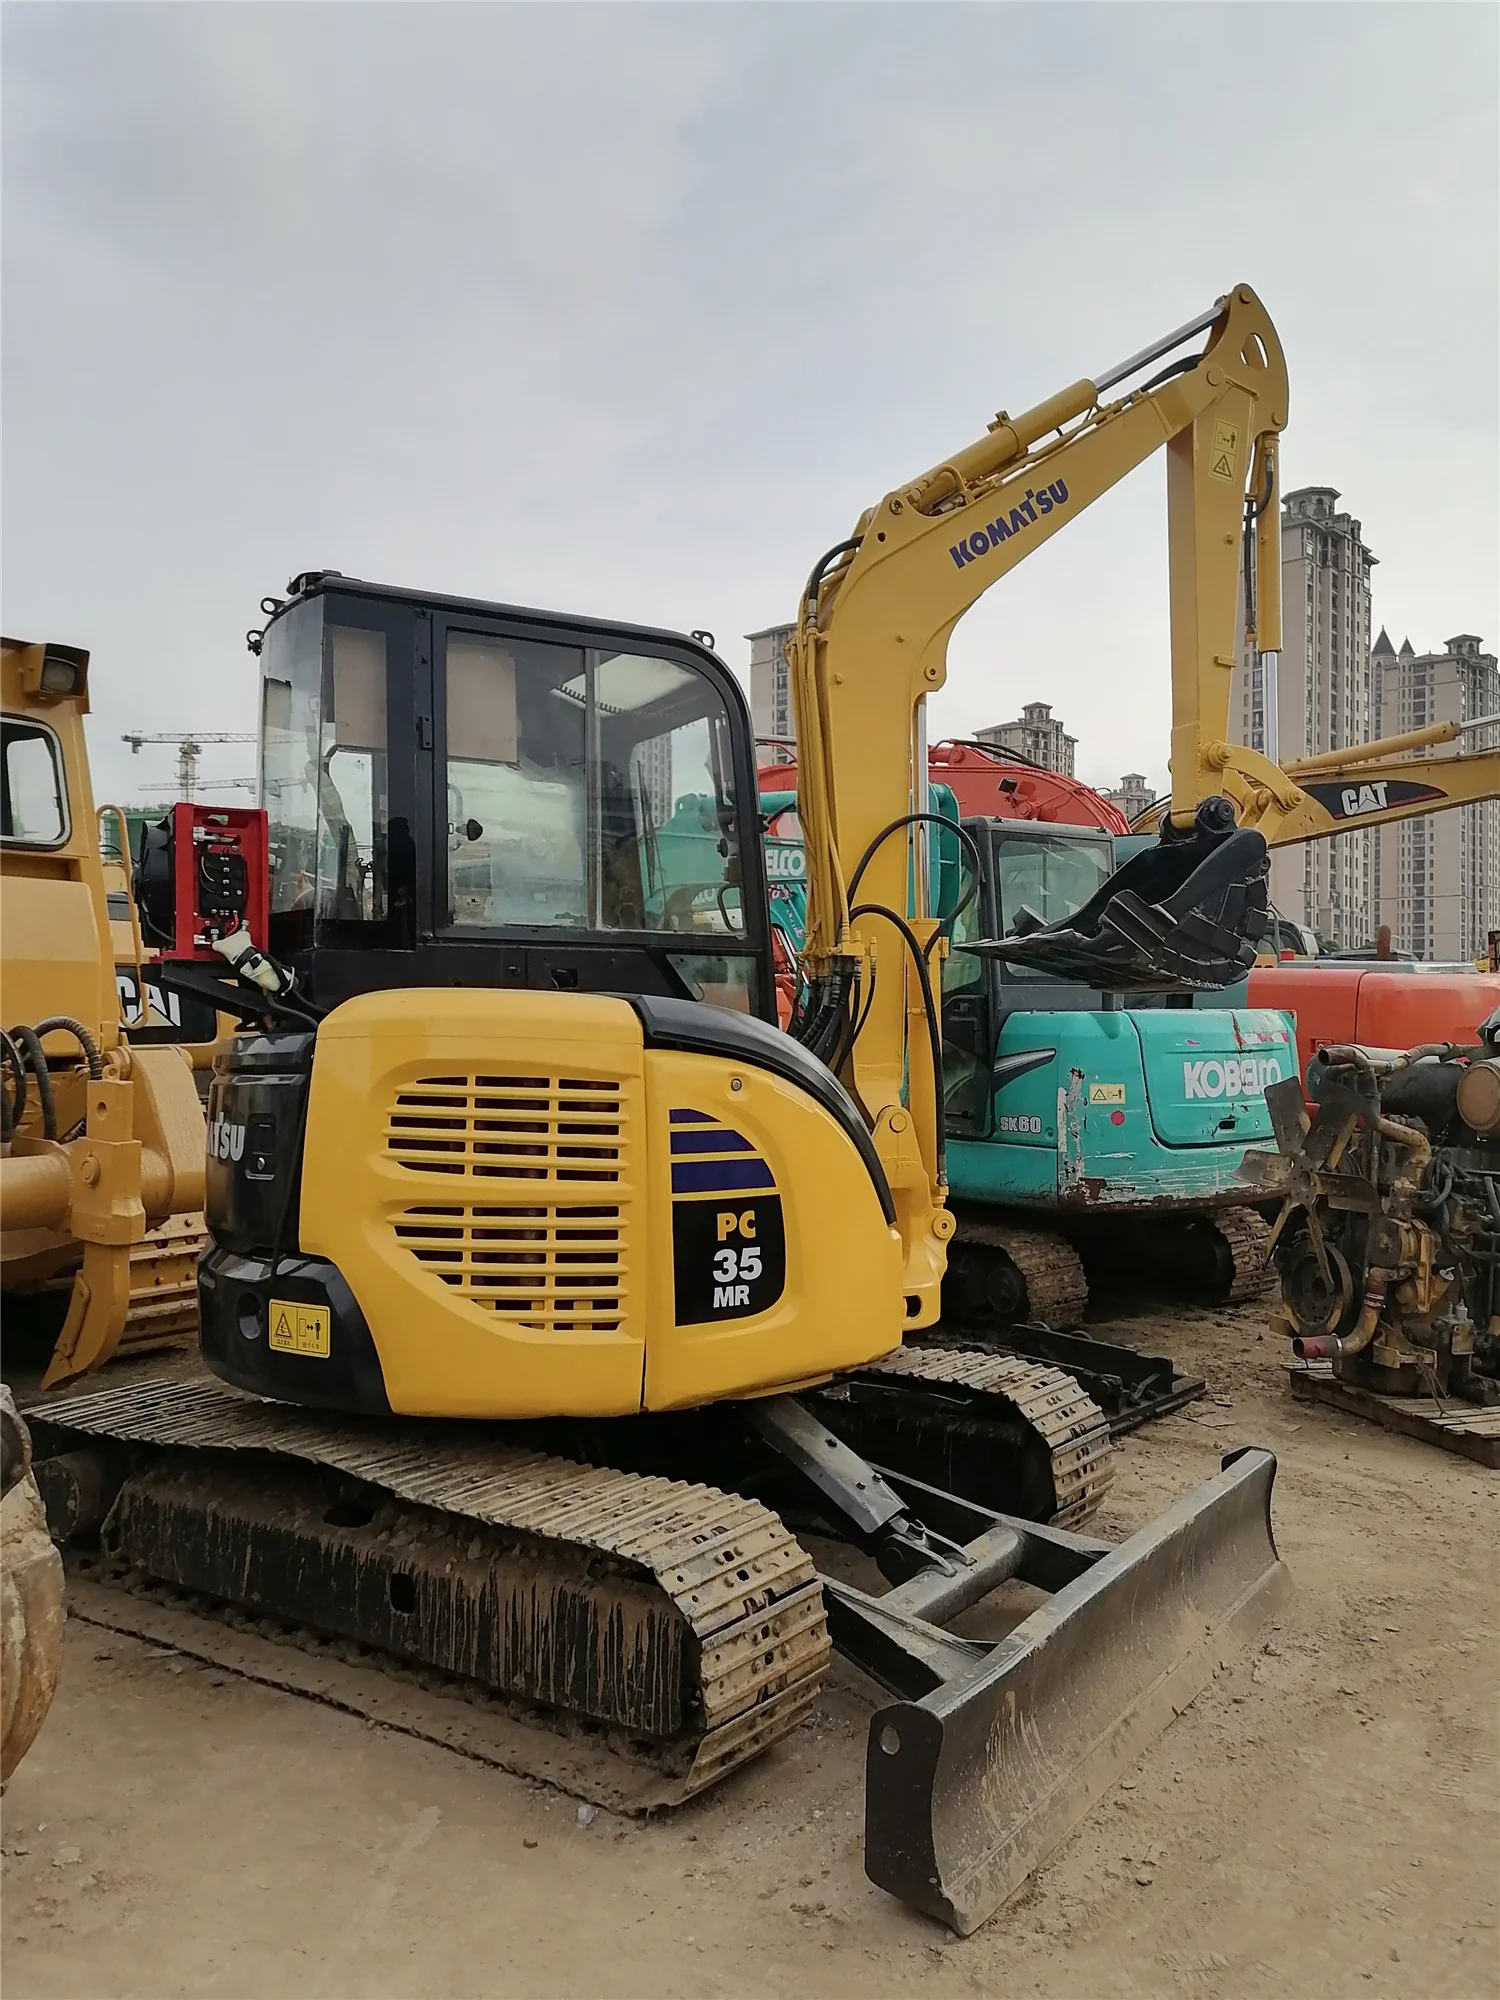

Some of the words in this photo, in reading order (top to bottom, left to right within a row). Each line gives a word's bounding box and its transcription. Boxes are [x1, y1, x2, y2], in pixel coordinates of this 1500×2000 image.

[948, 478, 1069, 569] KOMATSU
[1341, 781, 1388, 816] CAT
[1183, 1058, 1282, 1100] KOBELCO
[1000, 1115, 1042, 1134] SK60
[716, 1210, 756, 1242] PC
[712, 1246, 763, 1283] 35
[713, 1284, 750, 1309] MR
